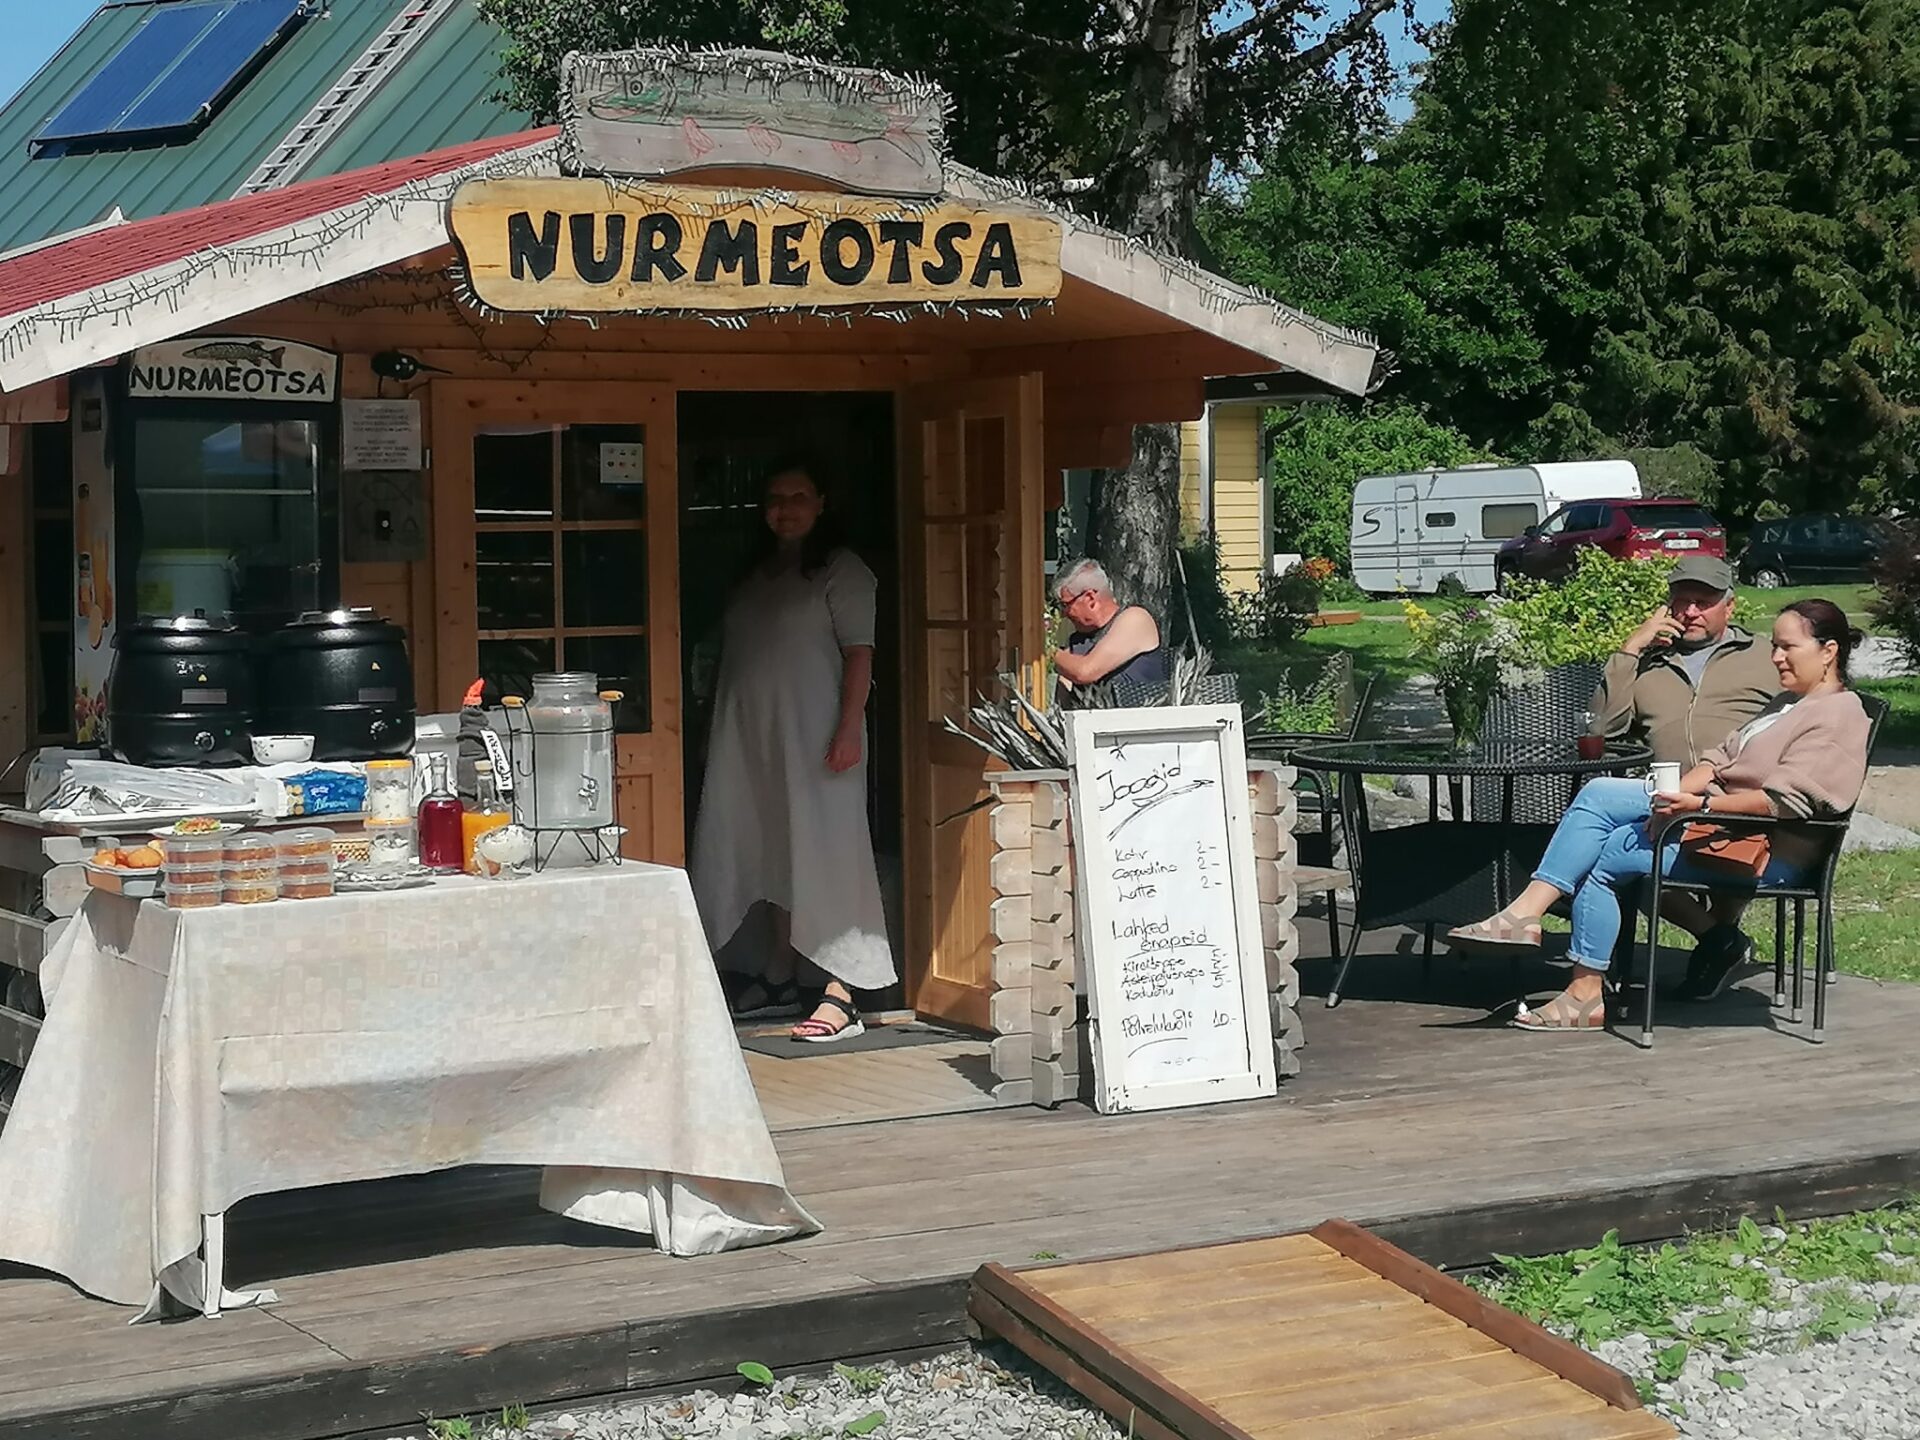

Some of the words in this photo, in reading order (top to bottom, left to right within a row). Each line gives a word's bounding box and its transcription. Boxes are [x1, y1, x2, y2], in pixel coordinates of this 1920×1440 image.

[507, 211, 1024, 288] NURMEOTSA
[129, 364, 327, 396] NURMEOTSA
[1096, 745, 1181, 812] Joogid
